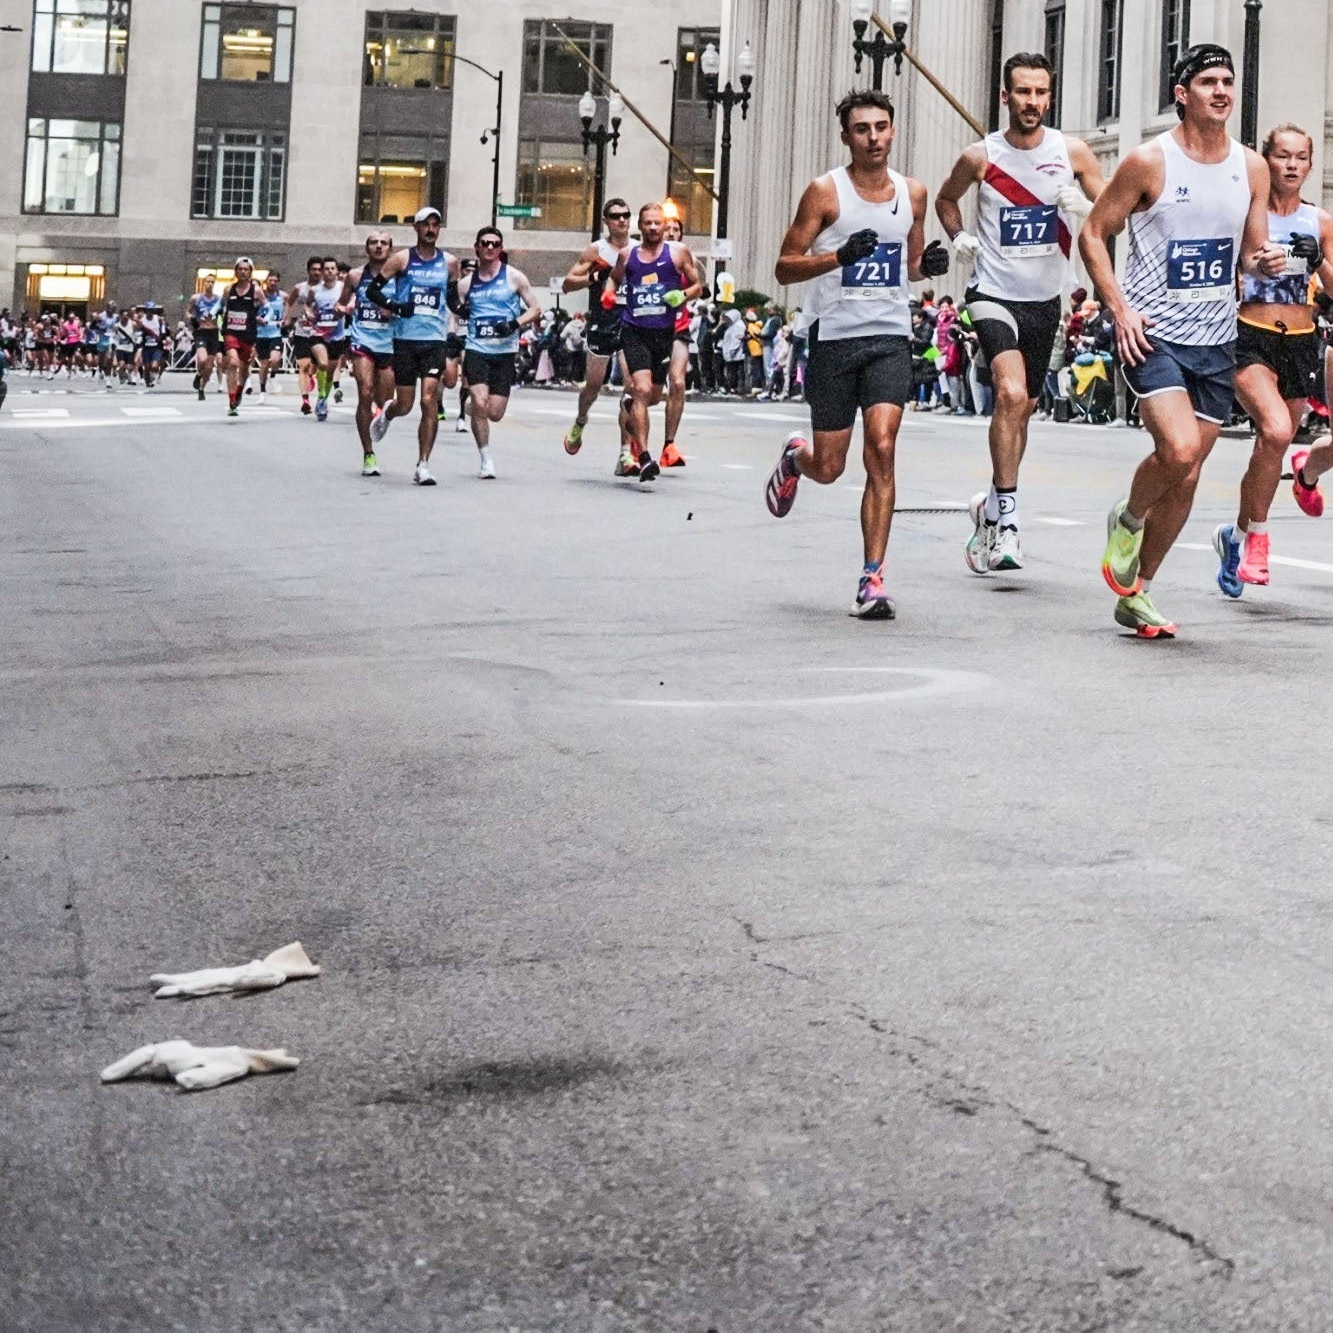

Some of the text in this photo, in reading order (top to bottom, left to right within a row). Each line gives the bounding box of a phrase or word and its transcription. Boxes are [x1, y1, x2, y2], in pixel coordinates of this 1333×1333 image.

[1010, 222, 1047, 240] 717
[854, 262, 890, 281] 721
[1180, 259, 1223, 281] 516
[414, 294, 436, 306] 848
[637, 293, 661, 305] 645
[480, 326, 498, 336] 85
